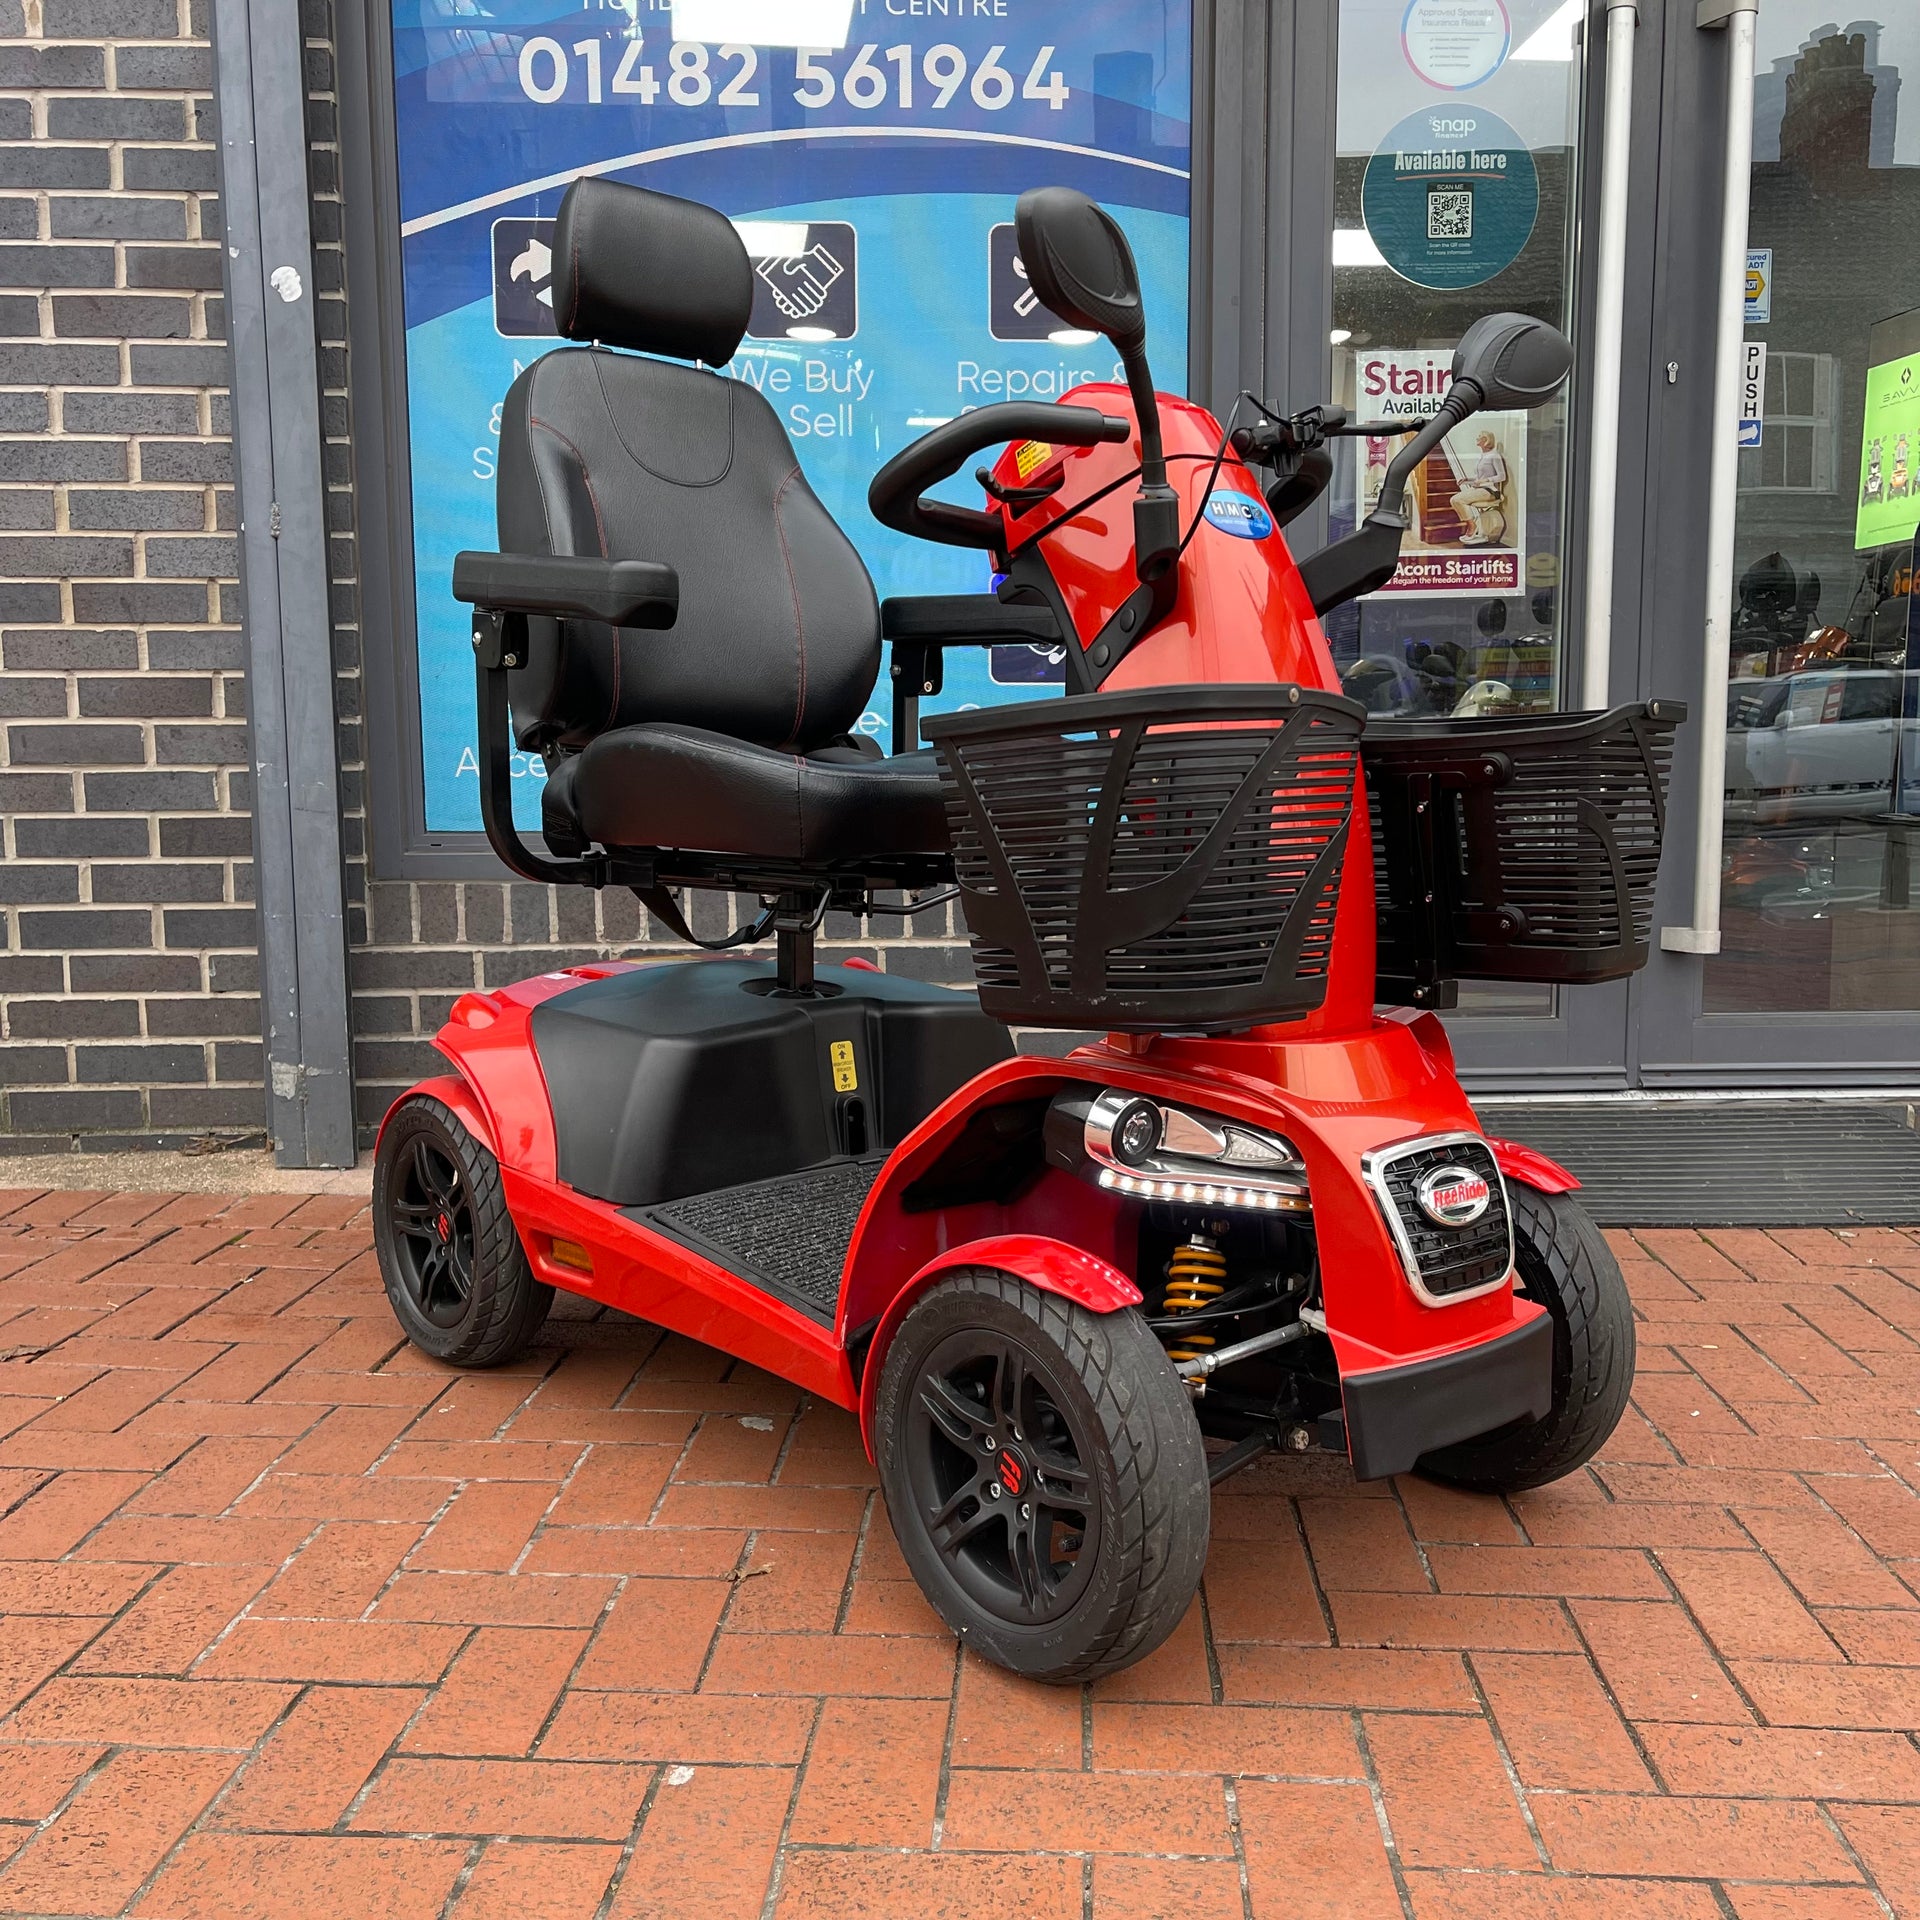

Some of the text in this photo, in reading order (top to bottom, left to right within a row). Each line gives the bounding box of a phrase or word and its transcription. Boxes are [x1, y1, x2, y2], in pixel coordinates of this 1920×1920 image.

[885, 0, 1008, 17] CENTRE
[518, 36, 1070, 110] 01482 561964
[1431, 118, 1477, 137] snap
[1394, 149, 1507, 171] Available here
[1436, 183, 1465, 191] SCAN ME
[1748, 261, 1765, 269] ADT
[728, 359, 875, 401] We Buy
[1743, 346, 1760, 418] PUSH
[1382, 398, 1446, 415] Availab
[789, 403, 853, 437] Sell
[1393, 559, 1514, 577] Acorn Stairlifts
[1393, 575, 1514, 586] Regain the freedom of your home
